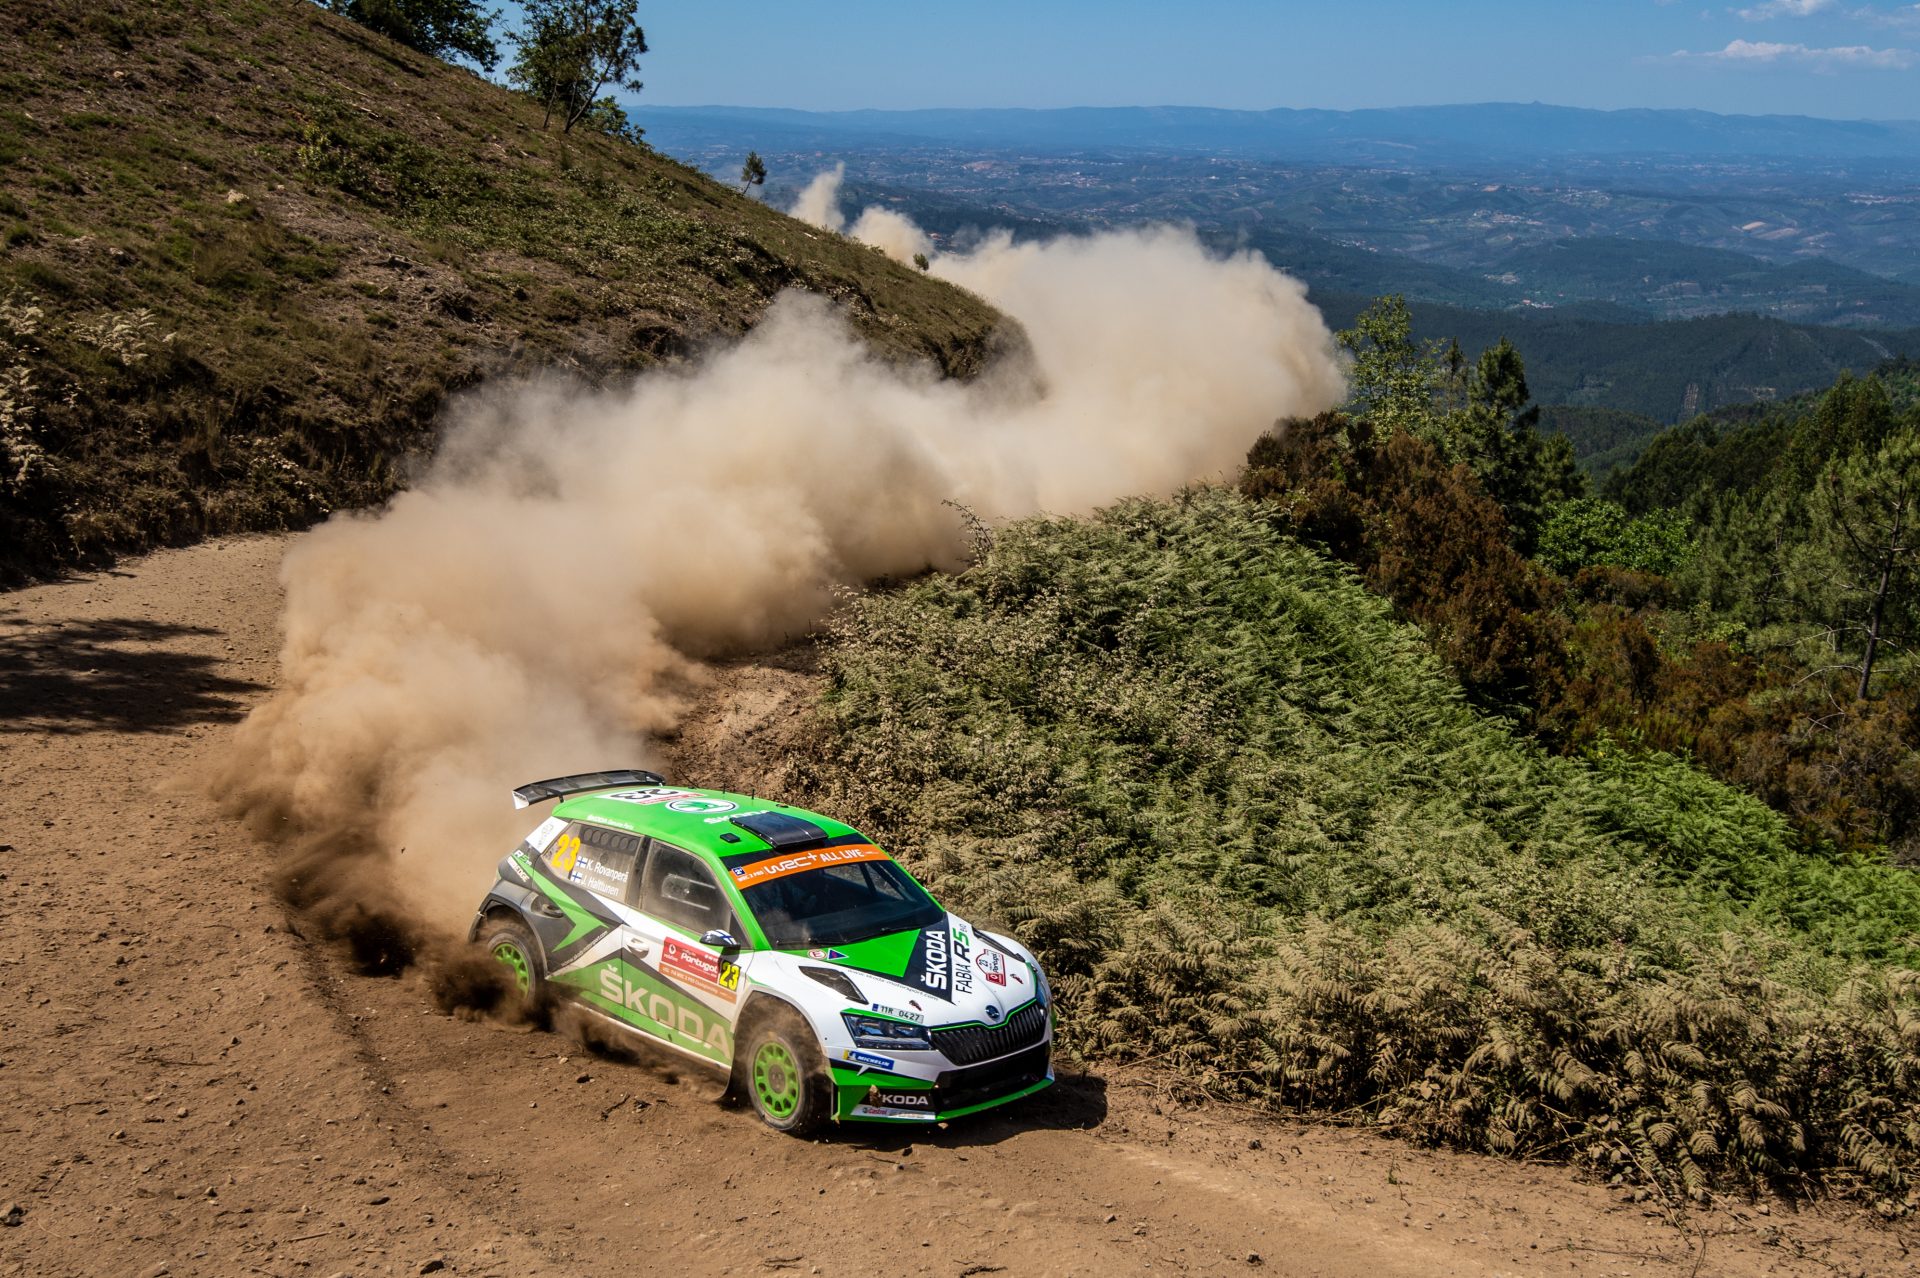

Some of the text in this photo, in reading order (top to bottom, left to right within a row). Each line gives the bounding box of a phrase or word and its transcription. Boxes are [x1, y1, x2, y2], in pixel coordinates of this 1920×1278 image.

[551, 834, 581, 872] 23
[819, 853, 842, 863] ALL
[841, 848, 865, 860] LIVE
[681, 952, 718, 974] Portugal
[719, 961, 740, 991] 23
[921, 931, 947, 990] ŠKODA
[956, 963, 972, 994] FABIA
[600, 963, 733, 1060] ŠKODA
[898, 1010, 920, 1021] 0427
[857, 1055, 890, 1067] MICHELIN
[878, 1093, 929, 1105] KODA
